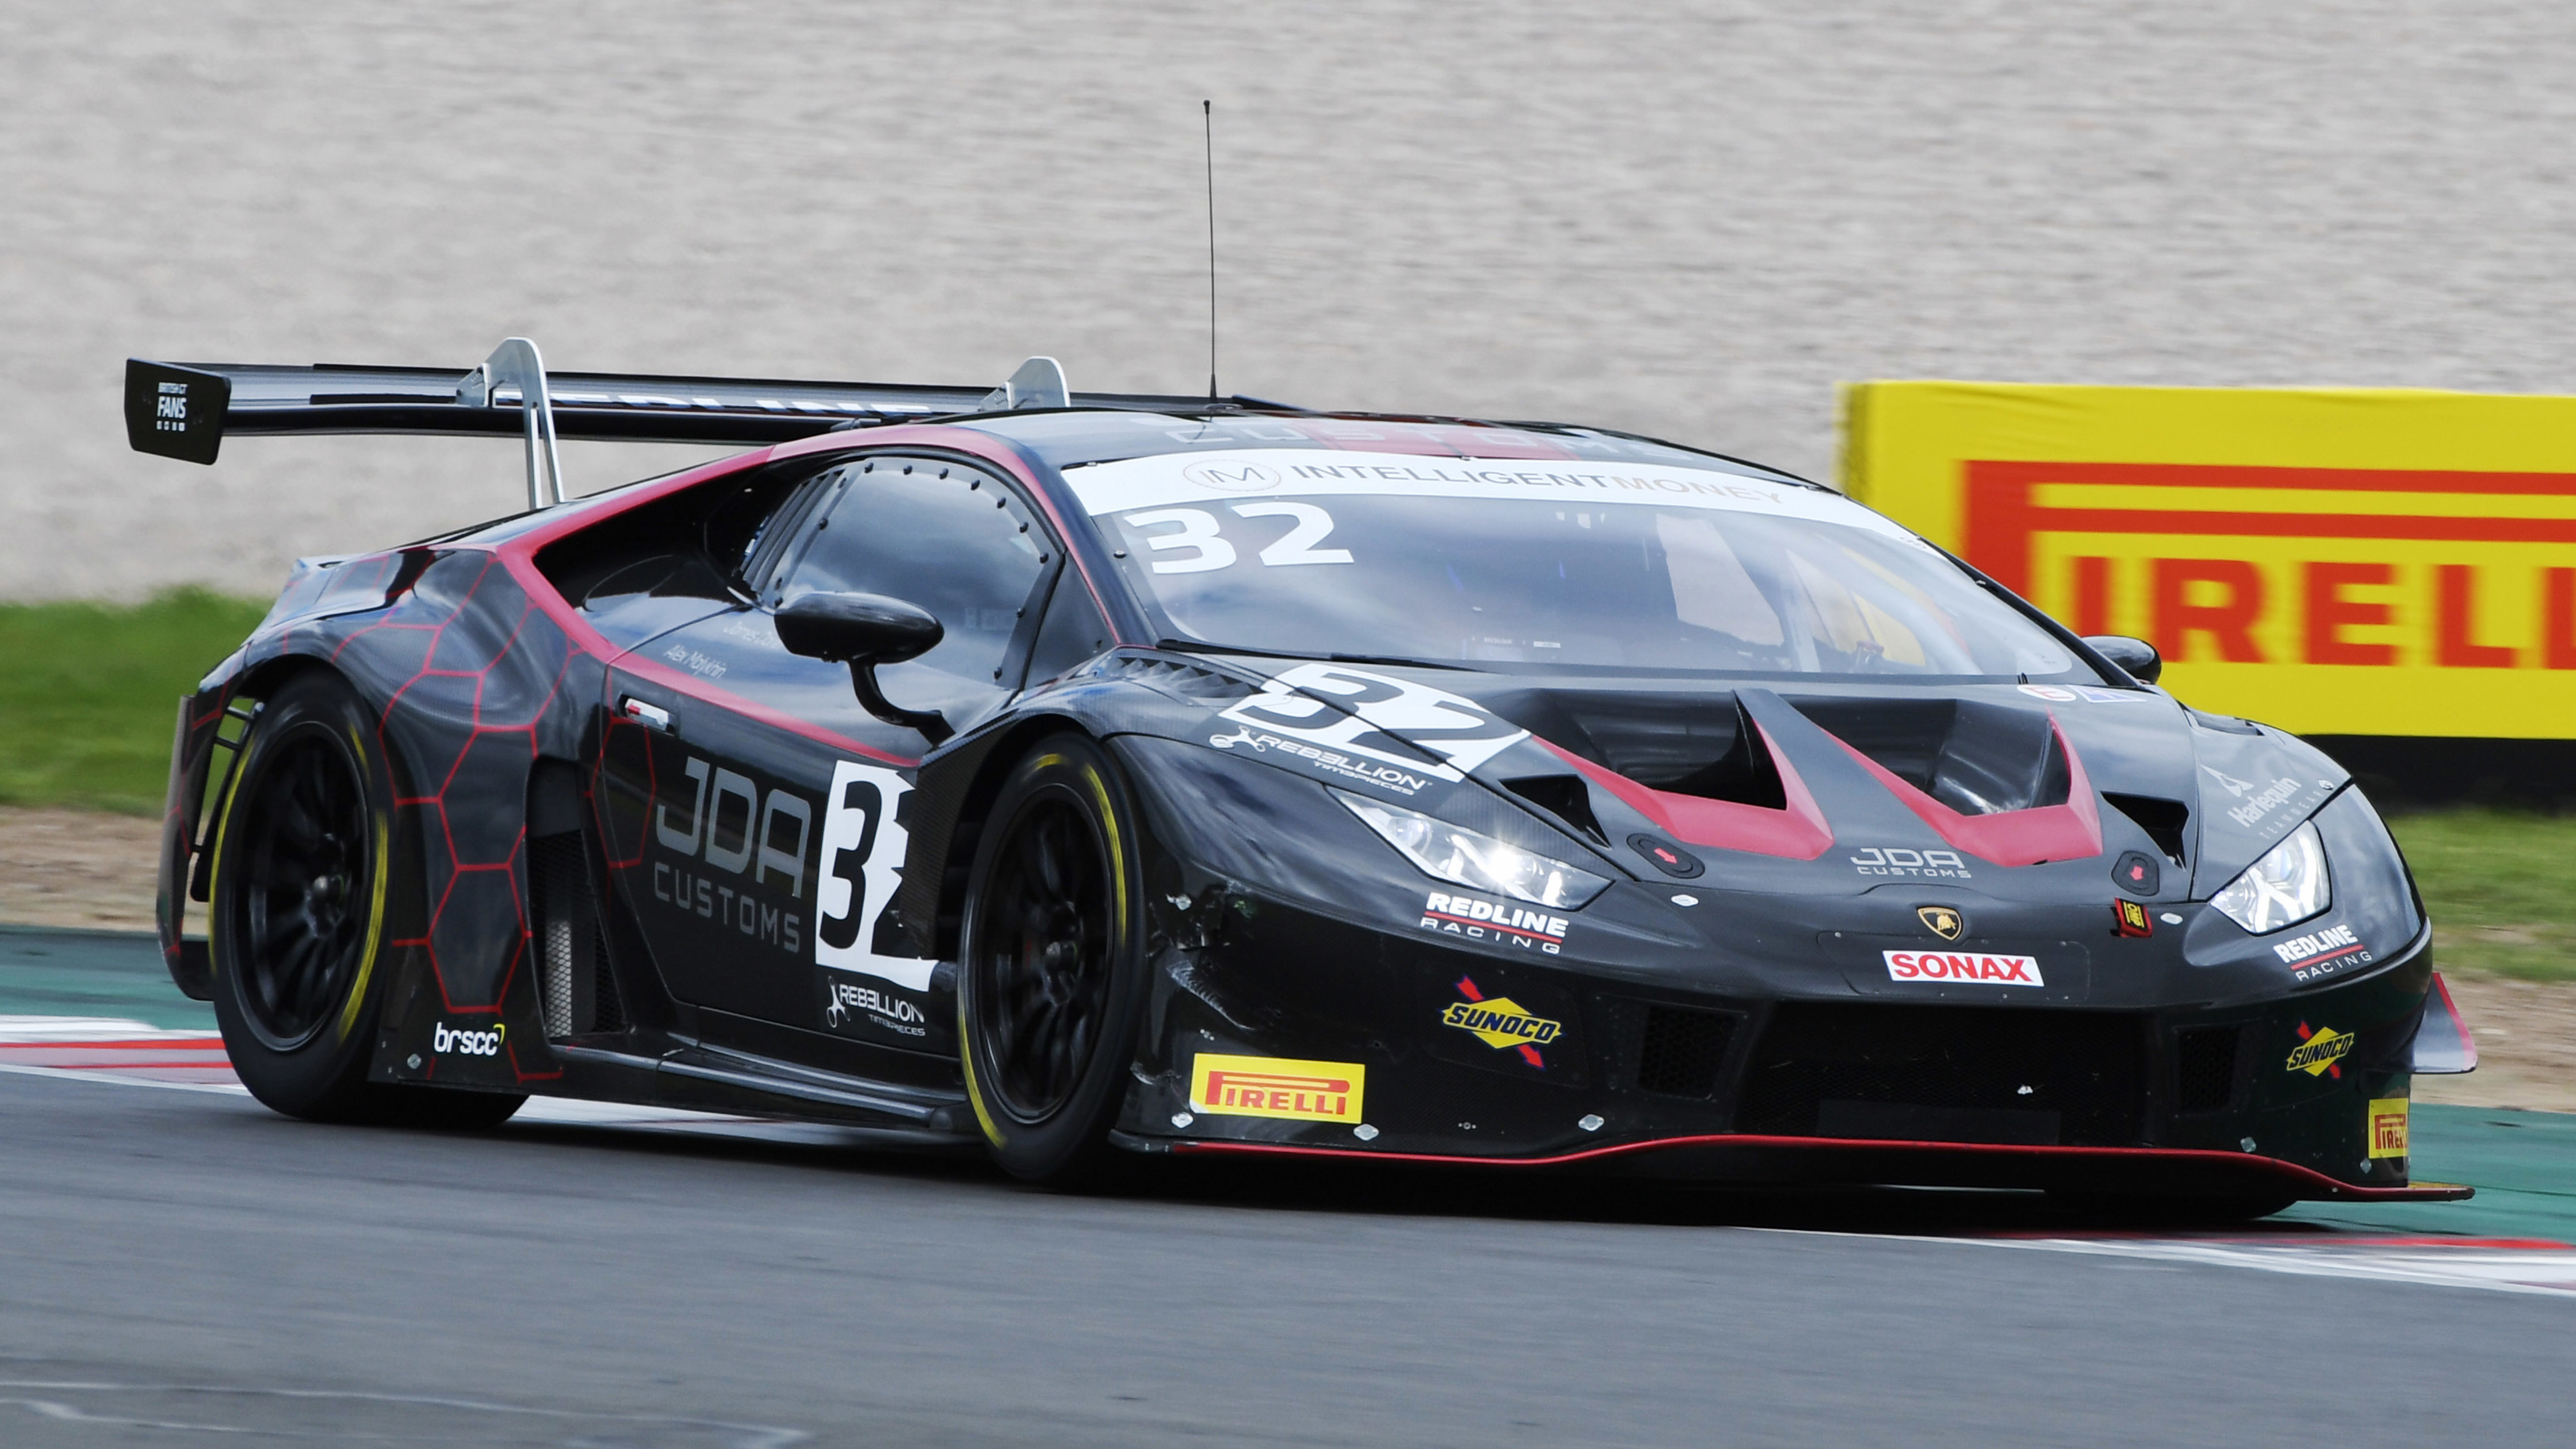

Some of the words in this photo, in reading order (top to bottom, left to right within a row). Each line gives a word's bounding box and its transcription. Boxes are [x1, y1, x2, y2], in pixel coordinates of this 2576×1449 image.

[157, 396, 187, 419] FANS
[1123, 502, 1355, 574] 32
[1236, 672, 1523, 767] 32
[2227, 777, 2302, 828] Harlequin
[655, 755, 812, 899] JDA
[1850, 848, 1965, 869] JDA
[1857, 866, 1972, 879] CUSTOMS
[654, 861, 800, 954] CUSTOMS
[1426, 892, 1570, 938] REDLINE
[1420, 916, 1560, 955] RACING
[2272, 924, 2359, 963] REDLINE
[1891, 954, 2034, 982] SONAX
[2295, 950, 2373, 982] RACING
[434, 1021, 499, 1056] brscc
[1447, 1005, 1557, 1041] SUNOCO
[2288, 1035, 2353, 1069] SUNOCO
[1205, 1070, 1350, 1116] PIRELLI
